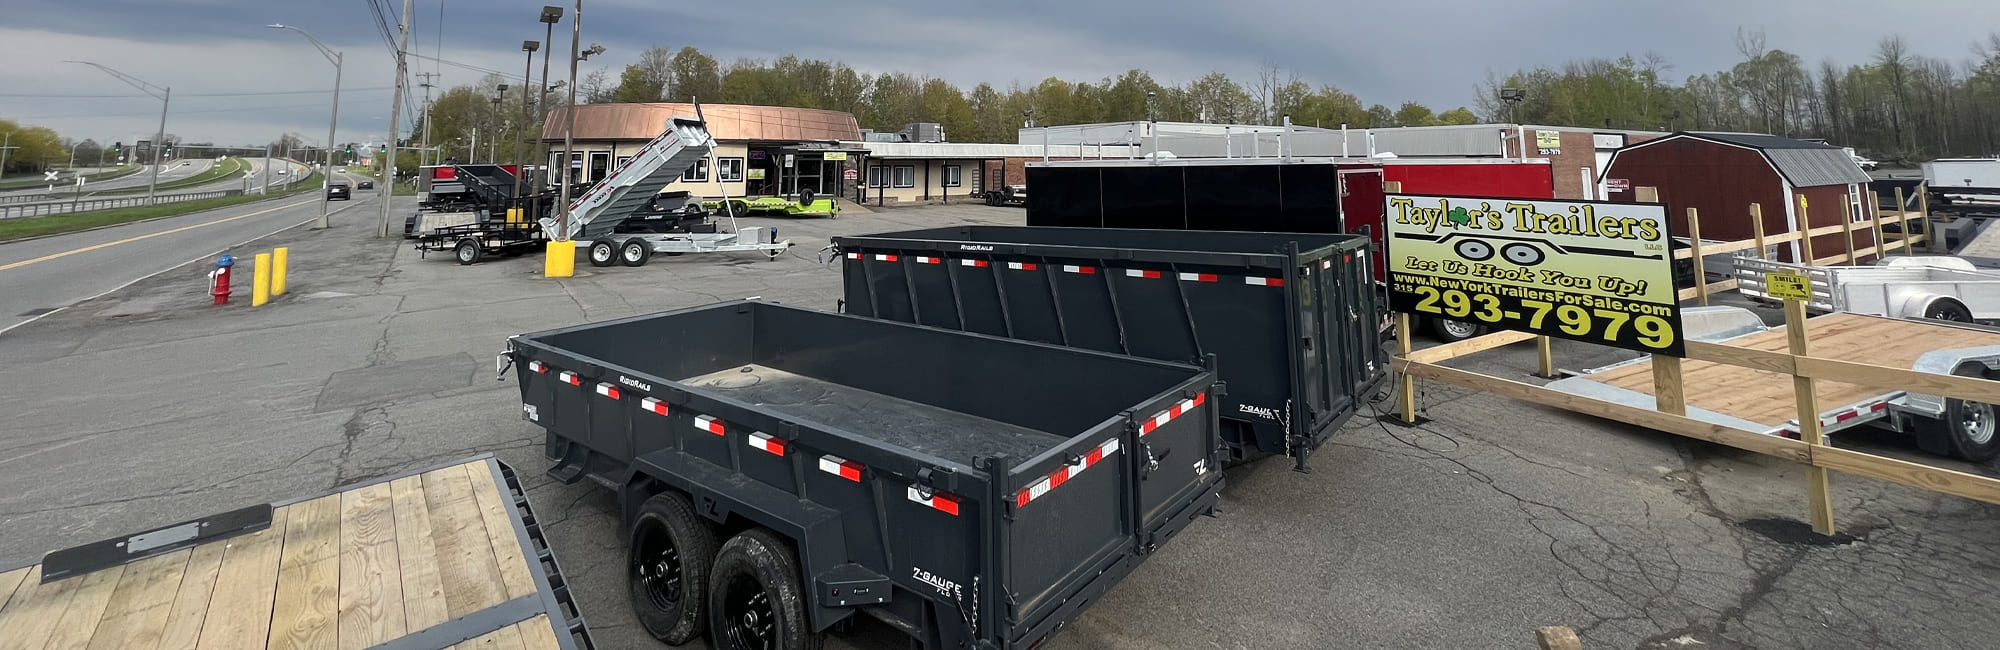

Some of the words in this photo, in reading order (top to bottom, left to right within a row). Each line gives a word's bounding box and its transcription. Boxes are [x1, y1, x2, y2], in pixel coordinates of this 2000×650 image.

[1505, 202, 1660, 241] Trailers
[1393, 273, 1671, 317] www.NewYorkTrailersForSale.com
[1405, 256, 1438, 272] Let
[1443, 260, 1468, 276] Us
[1472, 261, 1534, 284] Hook
[1540, 270, 1591, 289] You
[1597, 276, 1648, 296] Up!
[1393, 283, 1413, 293] 315
[1414, 286, 1675, 349] 293-7979
